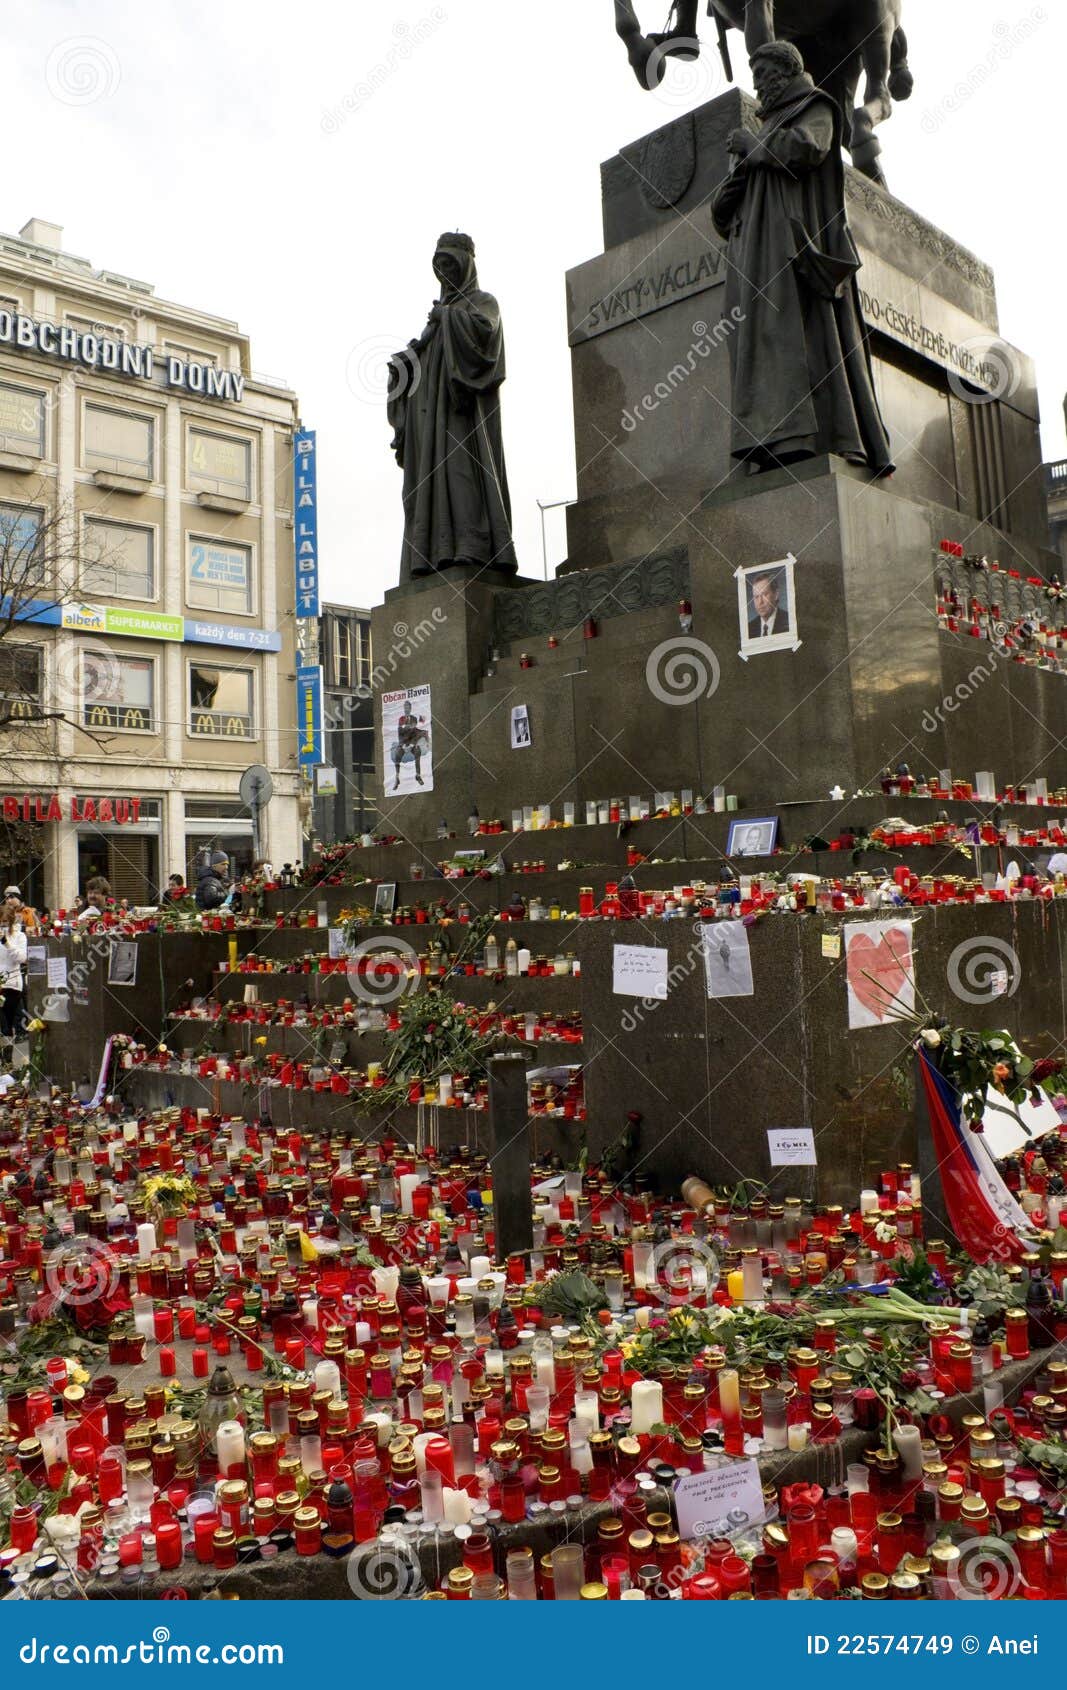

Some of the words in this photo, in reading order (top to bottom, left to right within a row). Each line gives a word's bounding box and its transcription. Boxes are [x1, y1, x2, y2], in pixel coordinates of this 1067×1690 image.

[170, 357, 245, 401] DOMY
[298, 439, 313, 507] BÍLÁ
[191, 546, 205, 578] 2
[65, 613, 102, 628] albert
[109, 614, 181, 634] SUPERMARKET
[195, 624, 226, 640] každý
[227, 625, 246, 641] den
[383, 692, 407, 703] Občan
[407, 686, 430, 699] Havel
